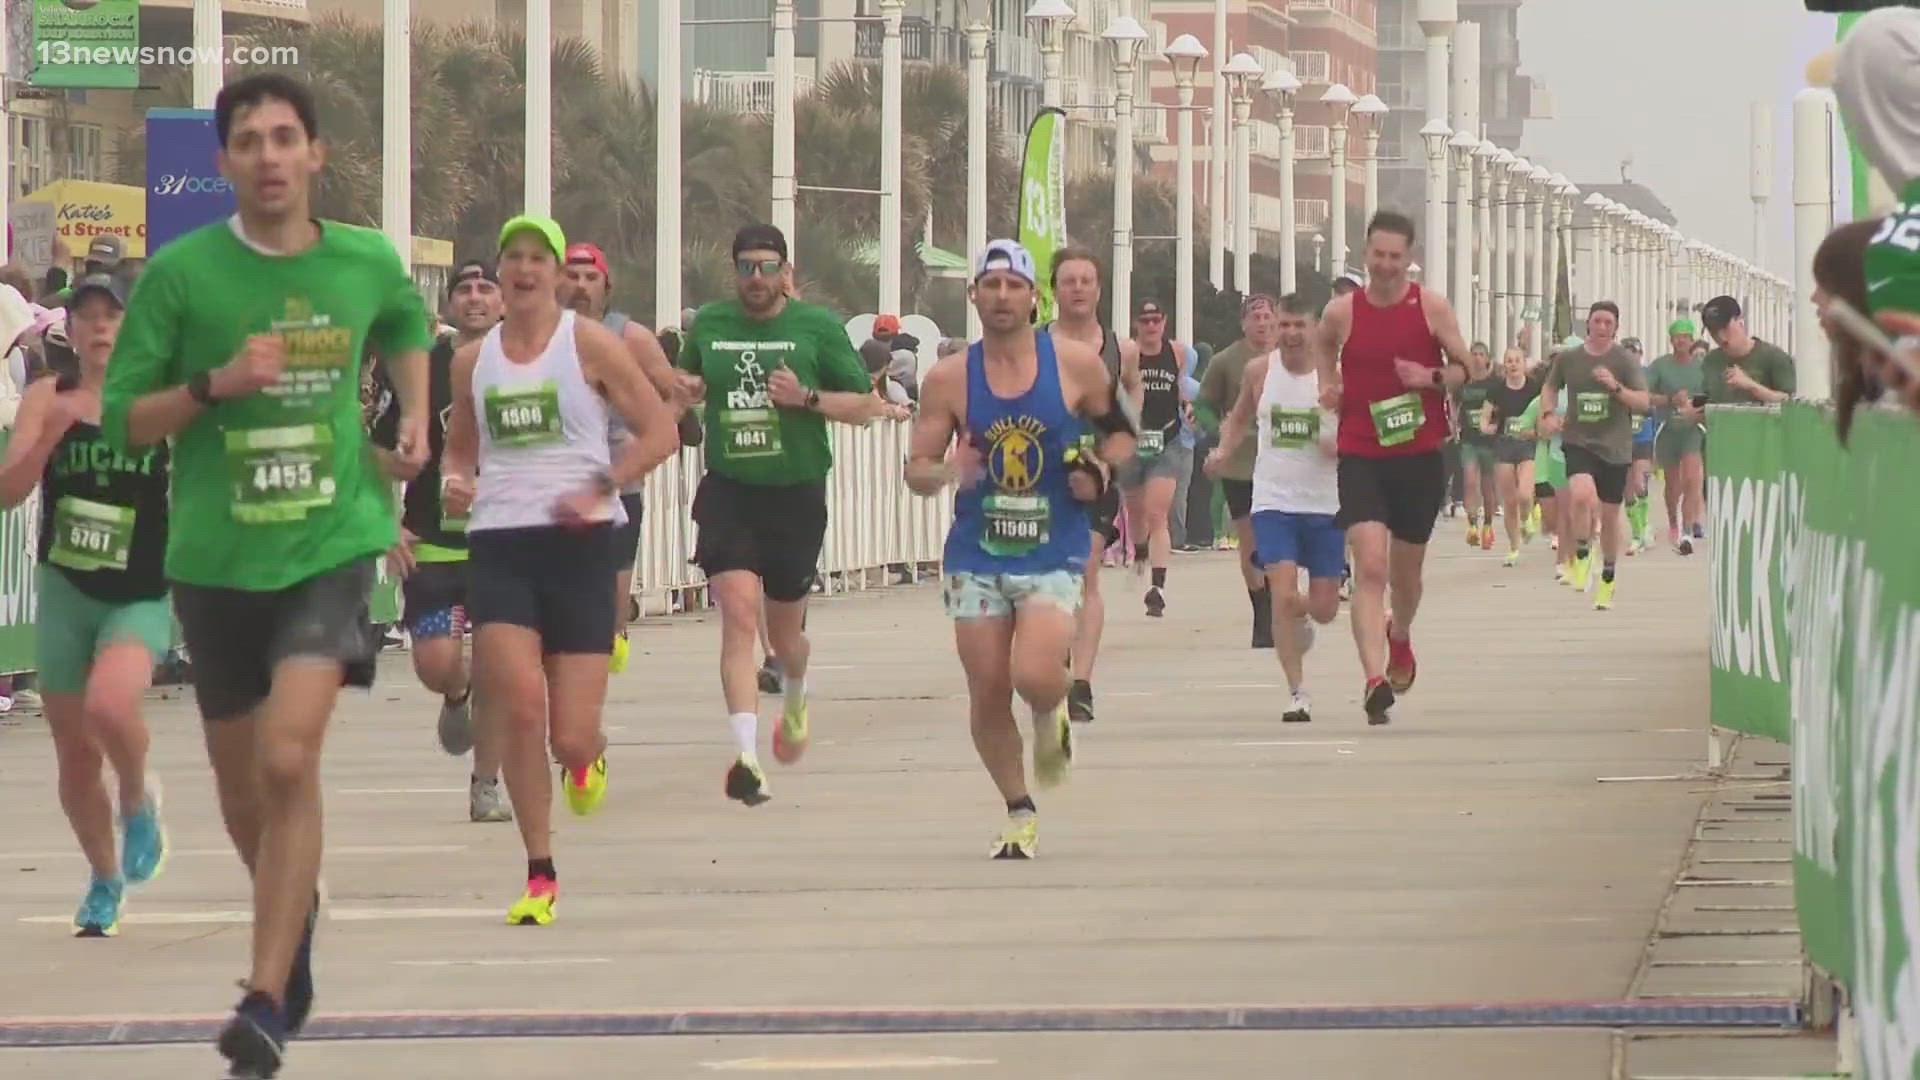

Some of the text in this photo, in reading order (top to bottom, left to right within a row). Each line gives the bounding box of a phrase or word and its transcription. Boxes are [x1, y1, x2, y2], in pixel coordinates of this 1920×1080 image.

[57, 203, 115, 221] Katie's
[74, 222, 132, 237] Street
[1018, 414, 1048, 436] CITY
[253, 464, 312, 491] 4455
